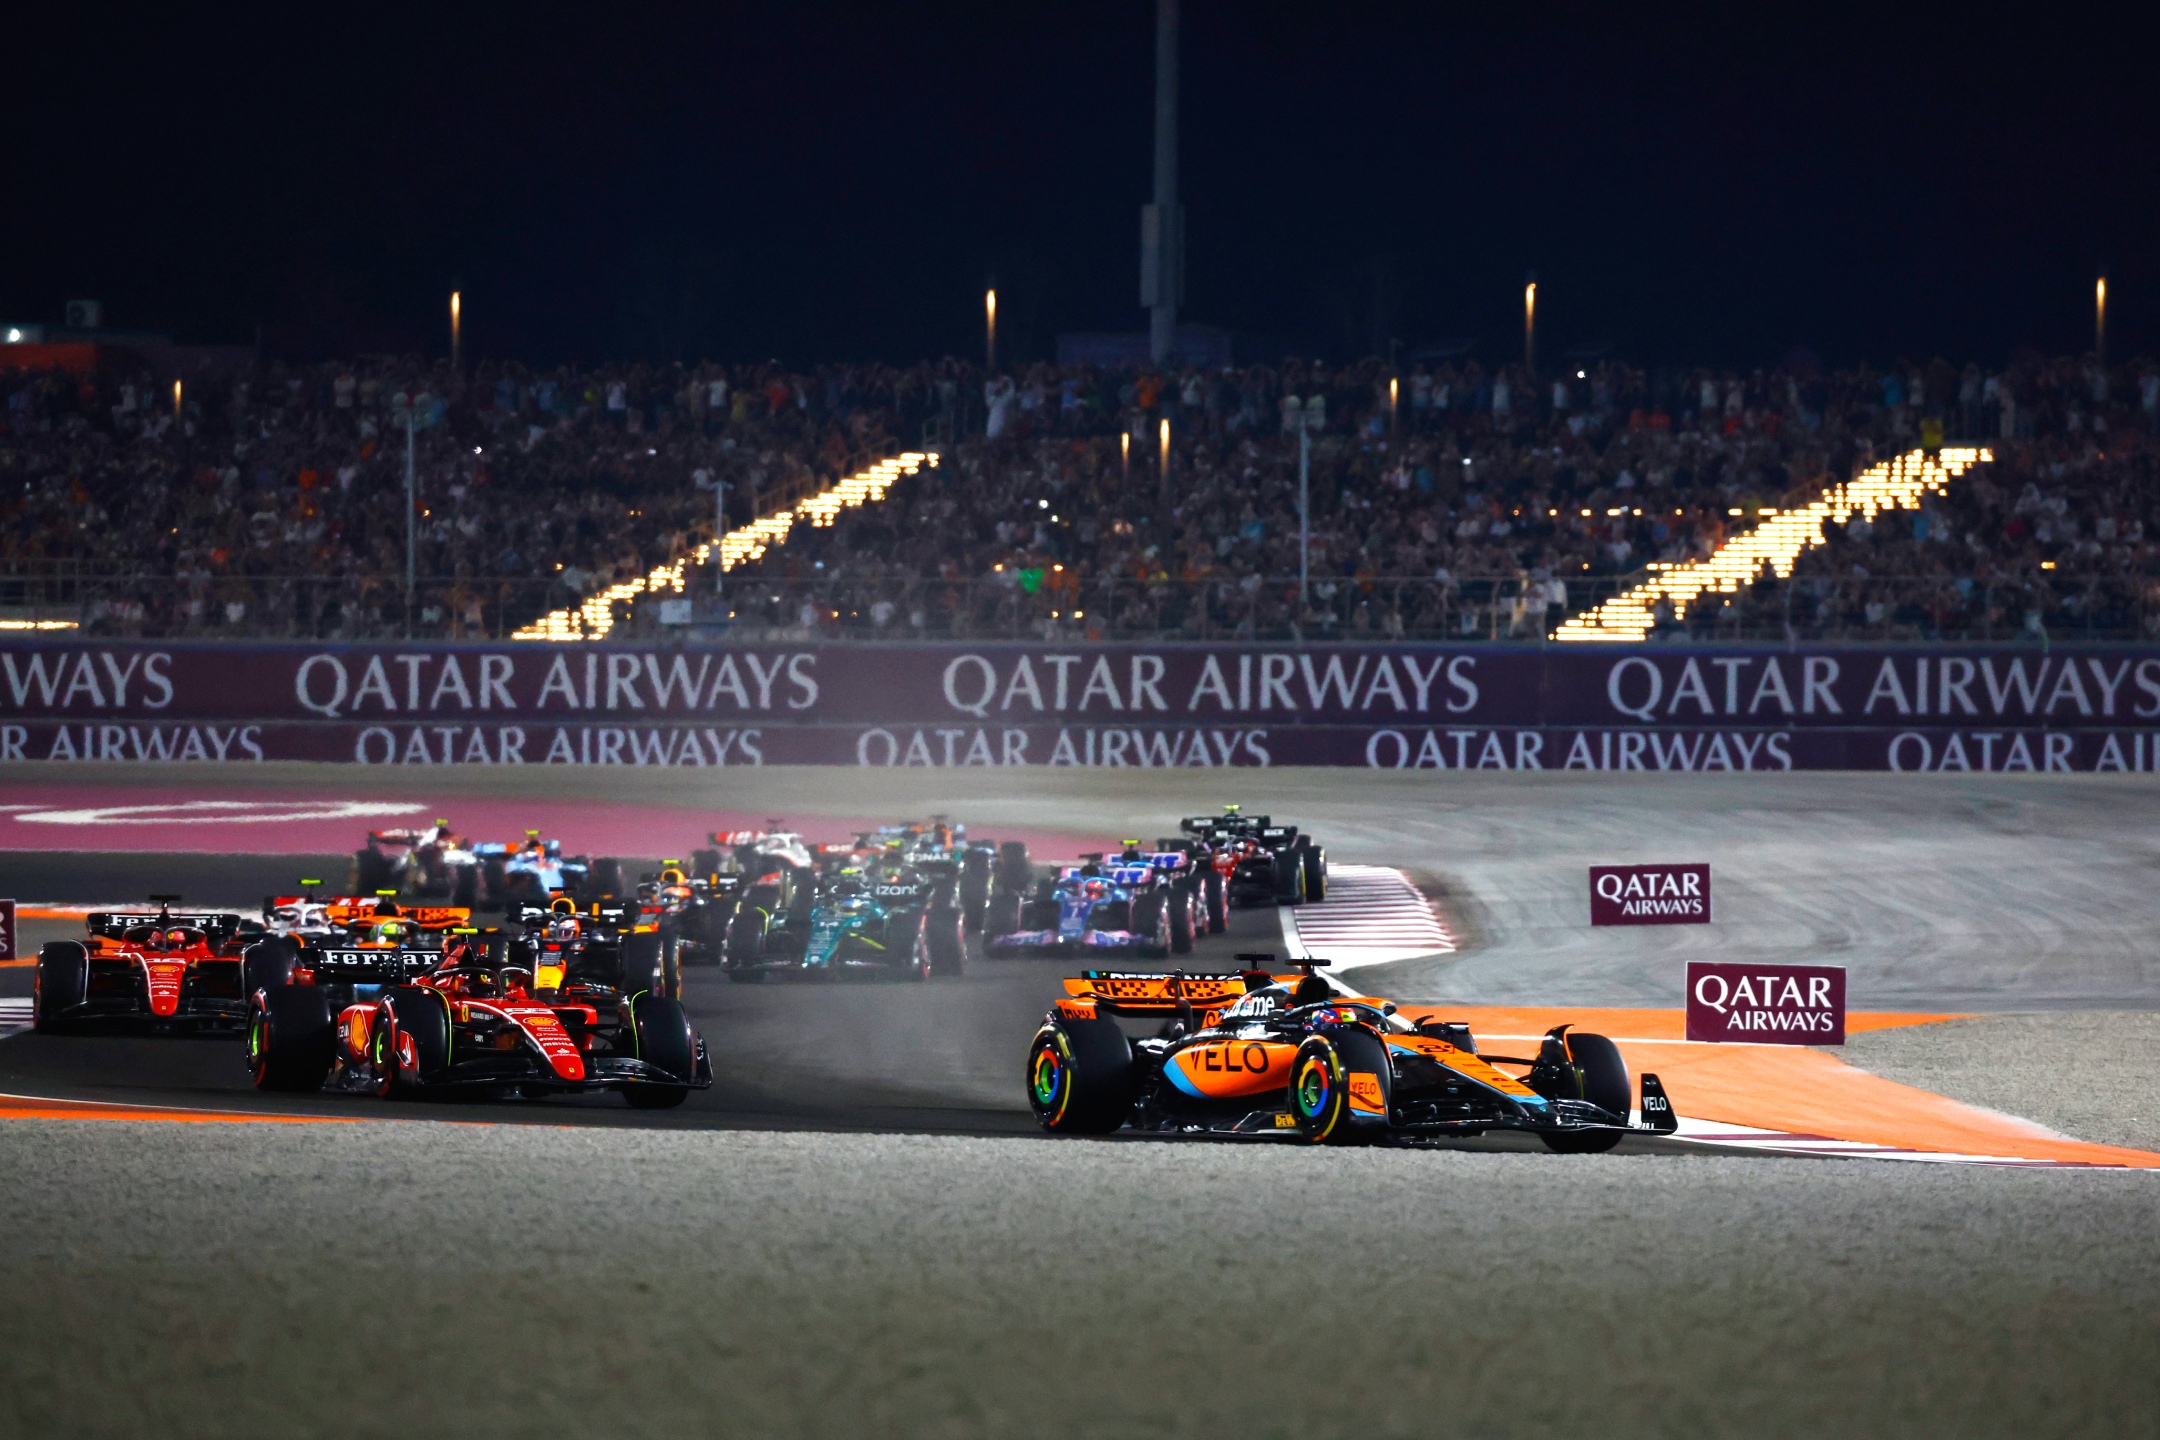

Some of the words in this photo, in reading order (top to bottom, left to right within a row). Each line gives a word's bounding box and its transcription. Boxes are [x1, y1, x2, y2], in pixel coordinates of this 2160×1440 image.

[295, 654, 517, 717] QATAR
[537, 652, 819, 711] AIRWAYS
[942, 654, 1168, 718] QATAR
[1188, 653, 1478, 712] AIRWAYS
[1607, 656, 1842, 721] QATAR
[1864, 656, 2160, 717] AIRWAYS
[48, 724, 264, 761] AIRWAYS
[355, 726, 526, 765] QATAR
[545, 727, 764, 766] AIRWAYS
[856, 728, 1029, 768] QATAR
[1049, 728, 1270, 768] AIRWAYS
[1366, 730, 1543, 769] QATAR
[1563, 731, 1792, 770] AIRWAYS
[1888, 732, 2073, 771] QATAR
[2095, 732, 2160, 772] AI
[1596, 872, 1701, 903] QATAR
[1622, 899, 1703, 915] AIRWAYS
[1695, 974, 1832, 1013] QATAR
[1727, 1010, 1834, 1032] AIRWAYS
[1190, 1041, 1269, 1074] VELO
[1351, 1082, 1376, 1095] VELO
[1642, 1096, 1667, 1110] VELO
